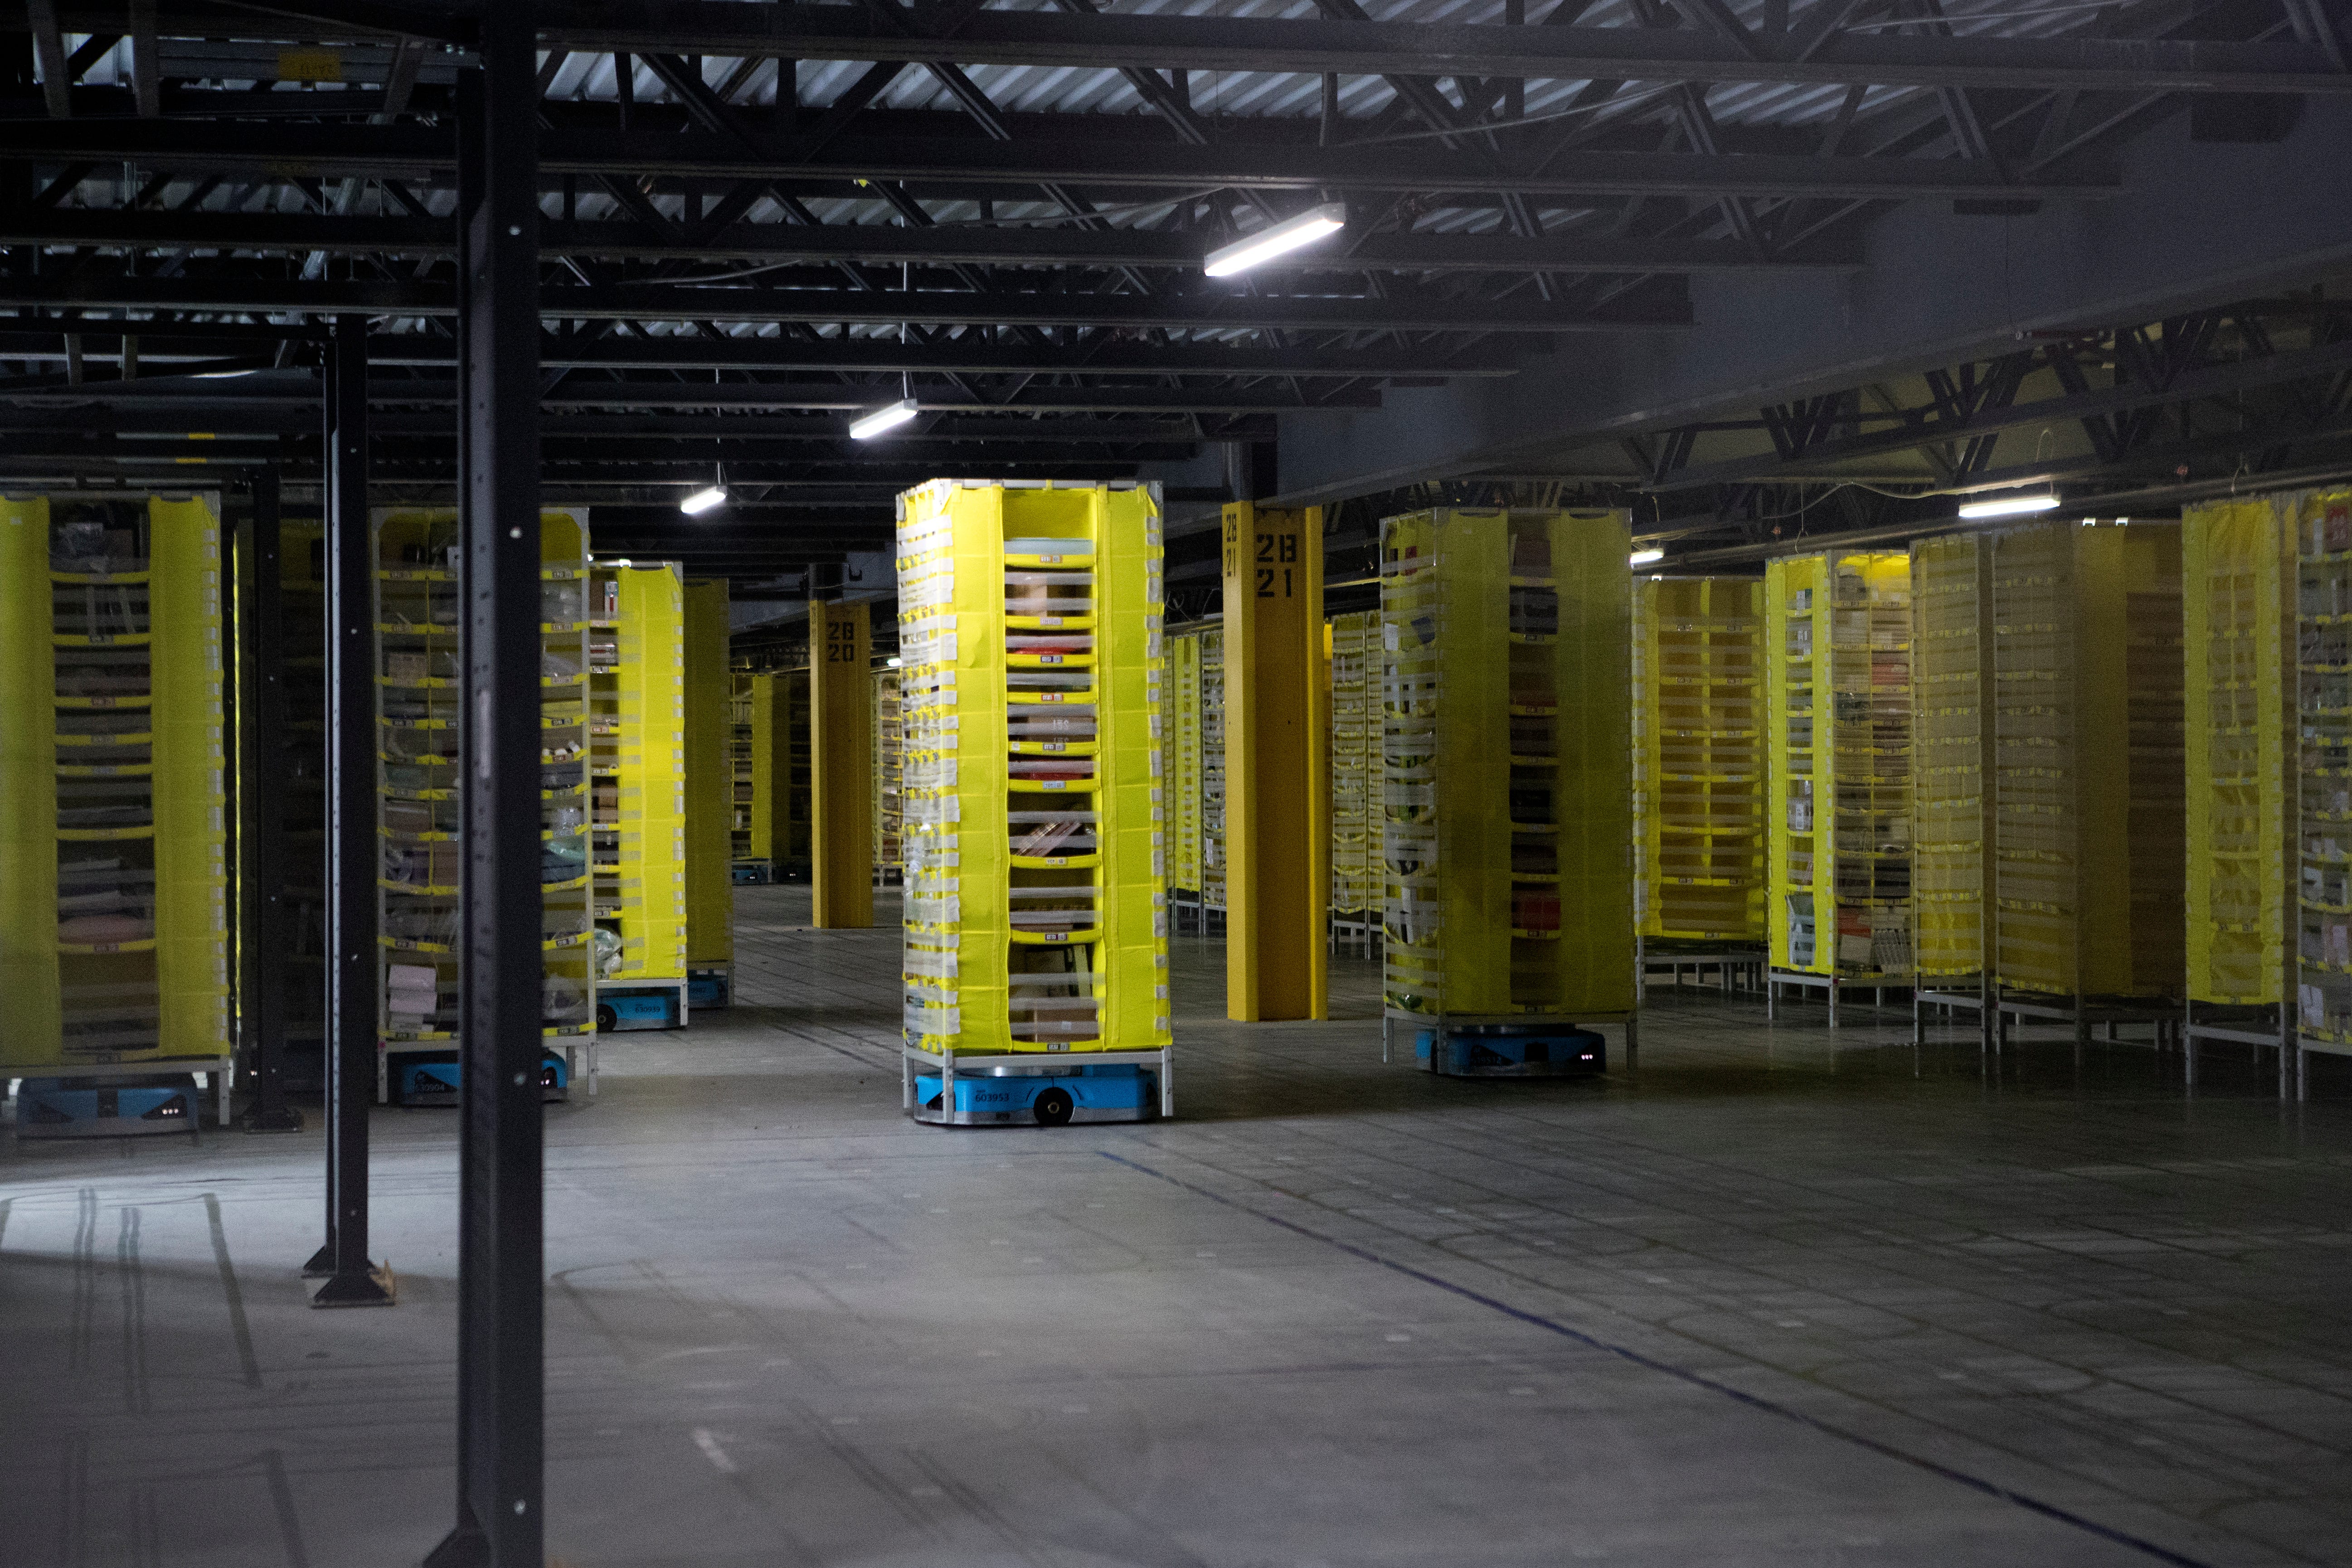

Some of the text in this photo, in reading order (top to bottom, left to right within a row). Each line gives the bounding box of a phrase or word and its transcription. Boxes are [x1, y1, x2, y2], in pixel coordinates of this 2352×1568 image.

[1227, 548, 1236, 577] 21
[1257, 568, 1292, 597] 21
[828, 644, 854, 662] 20
[975, 1092, 1009, 1102] 603953
